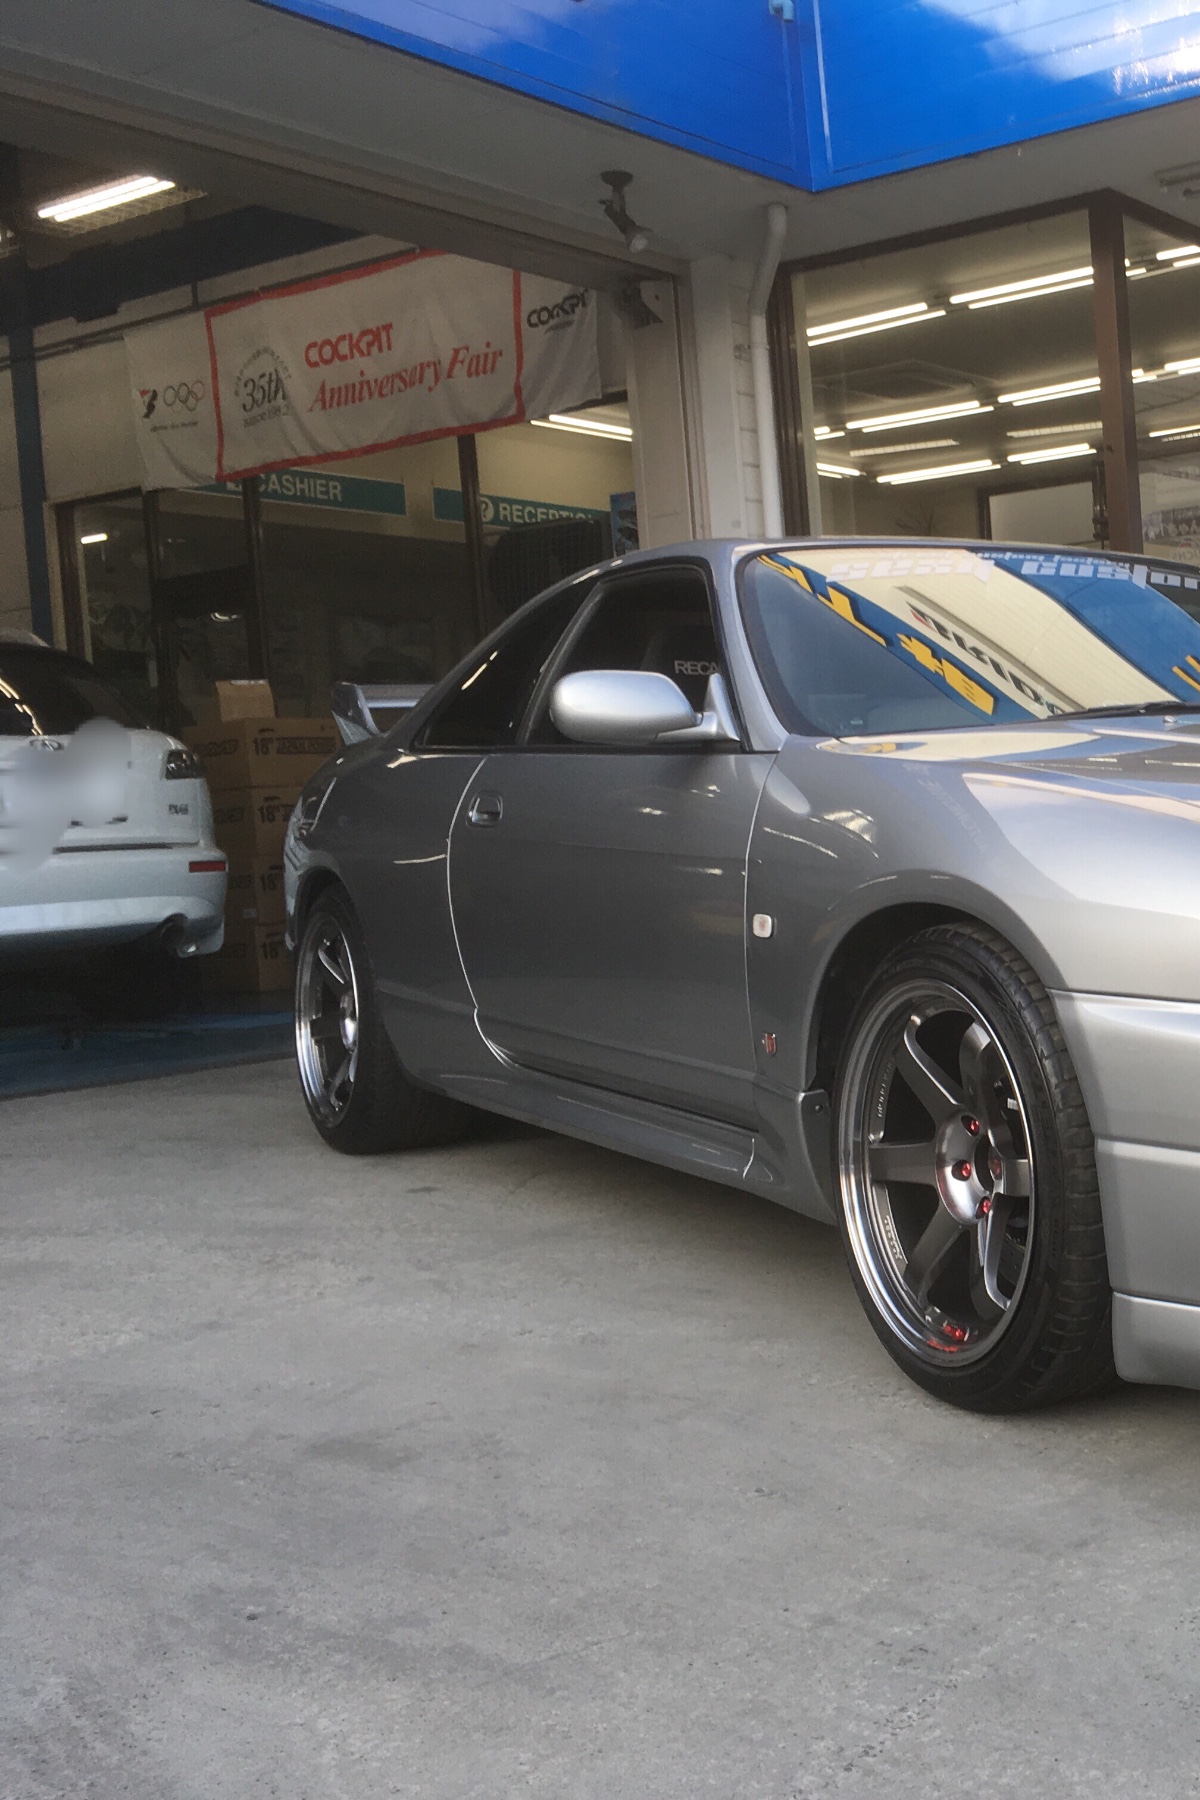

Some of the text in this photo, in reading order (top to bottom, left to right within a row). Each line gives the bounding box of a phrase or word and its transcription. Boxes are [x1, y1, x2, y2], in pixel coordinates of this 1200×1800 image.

[304, 322, 393, 369] COCKPIT
[242, 368, 287, 413] 35th
[307, 356, 442, 412] Anniversary
[446, 341, 503, 380] Fair
